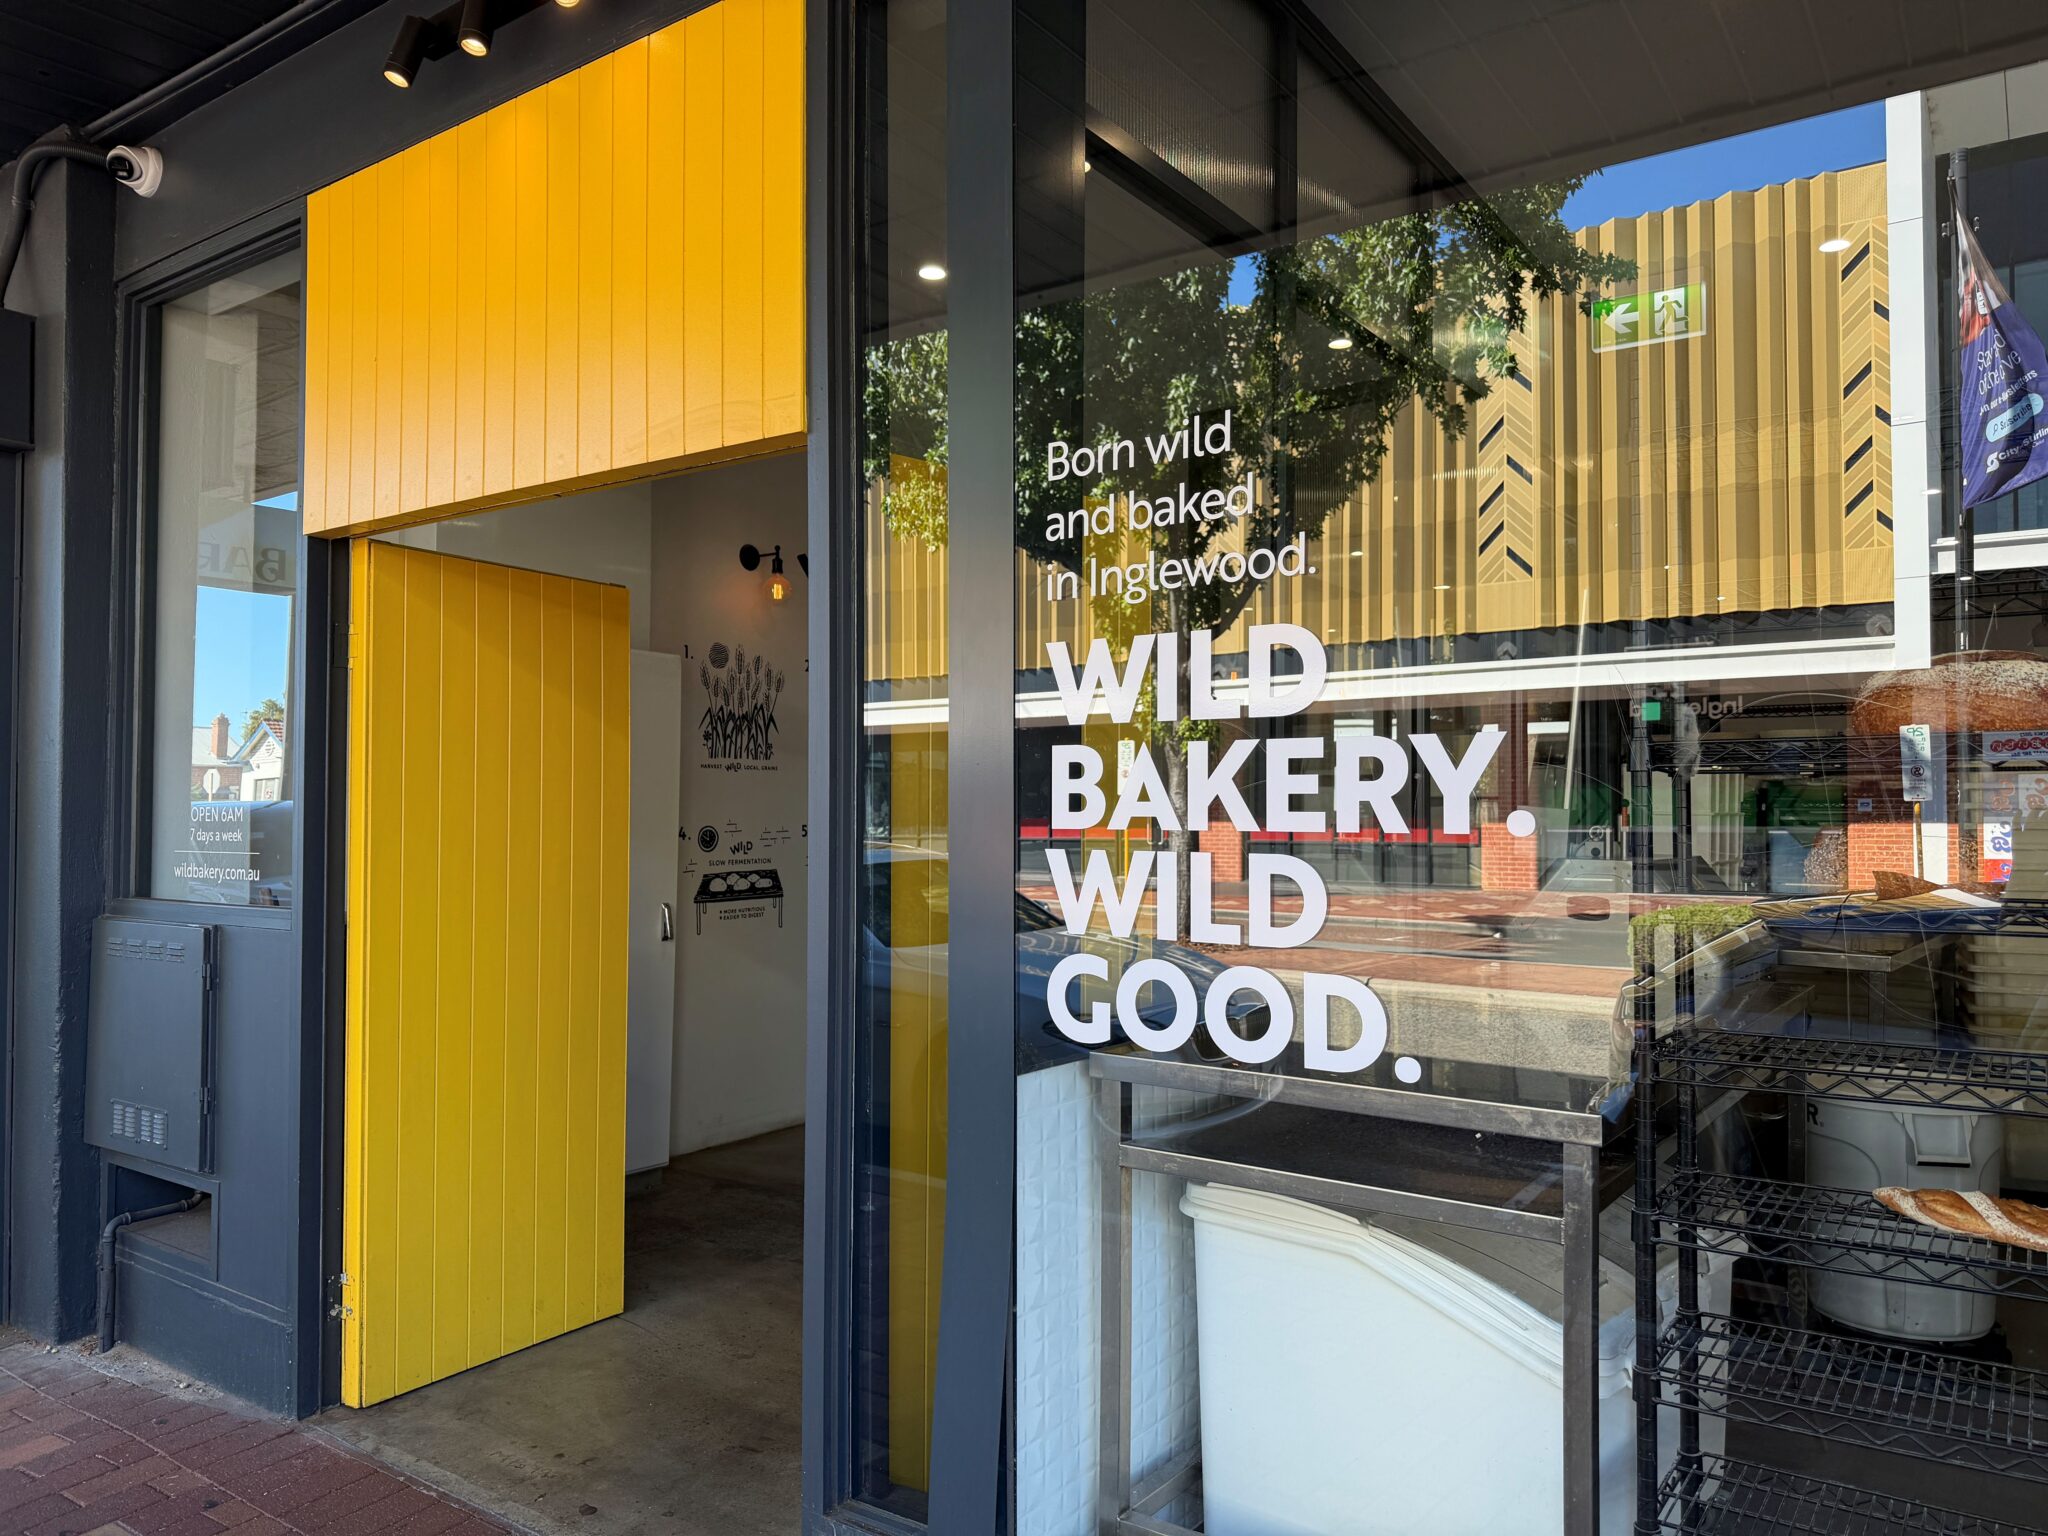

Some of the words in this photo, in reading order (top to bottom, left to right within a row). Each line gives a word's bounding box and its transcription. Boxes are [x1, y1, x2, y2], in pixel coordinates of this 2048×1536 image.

[1048, 441, 1135, 482] Born
[1145, 409, 1231, 465] wild
[2023, 427, 2048, 447] Stirlin
[1045, 493, 1115, 542] and
[1128, 472, 1253, 530] baked
[1047, 563, 1078, 602] in
[1090, 531, 1316, 605] Inglewood.
[684, 644, 694, 659] 1.
[1046, 623, 1328, 726] WILD
[725, 762, 742, 772] WILD
[1050, 731, 1537, 838] BAKERY.
[190, 806, 218, 822] OPEN
[221, 806, 244, 822] 6AM
[190, 828, 196, 841] 7
[196, 829, 214, 845] days
[215, 833, 220, 841] a
[222, 829, 243, 842] week
[679, 827, 691, 840] 4.
[730, 841, 753, 855] WILD
[728, 857, 772, 866] FERMENTATION
[174, 863, 260, 884] wildbakery.com.au
[1046, 848, 1329, 949] WILD
[1046, 953, 1423, 1084] GOOD.
